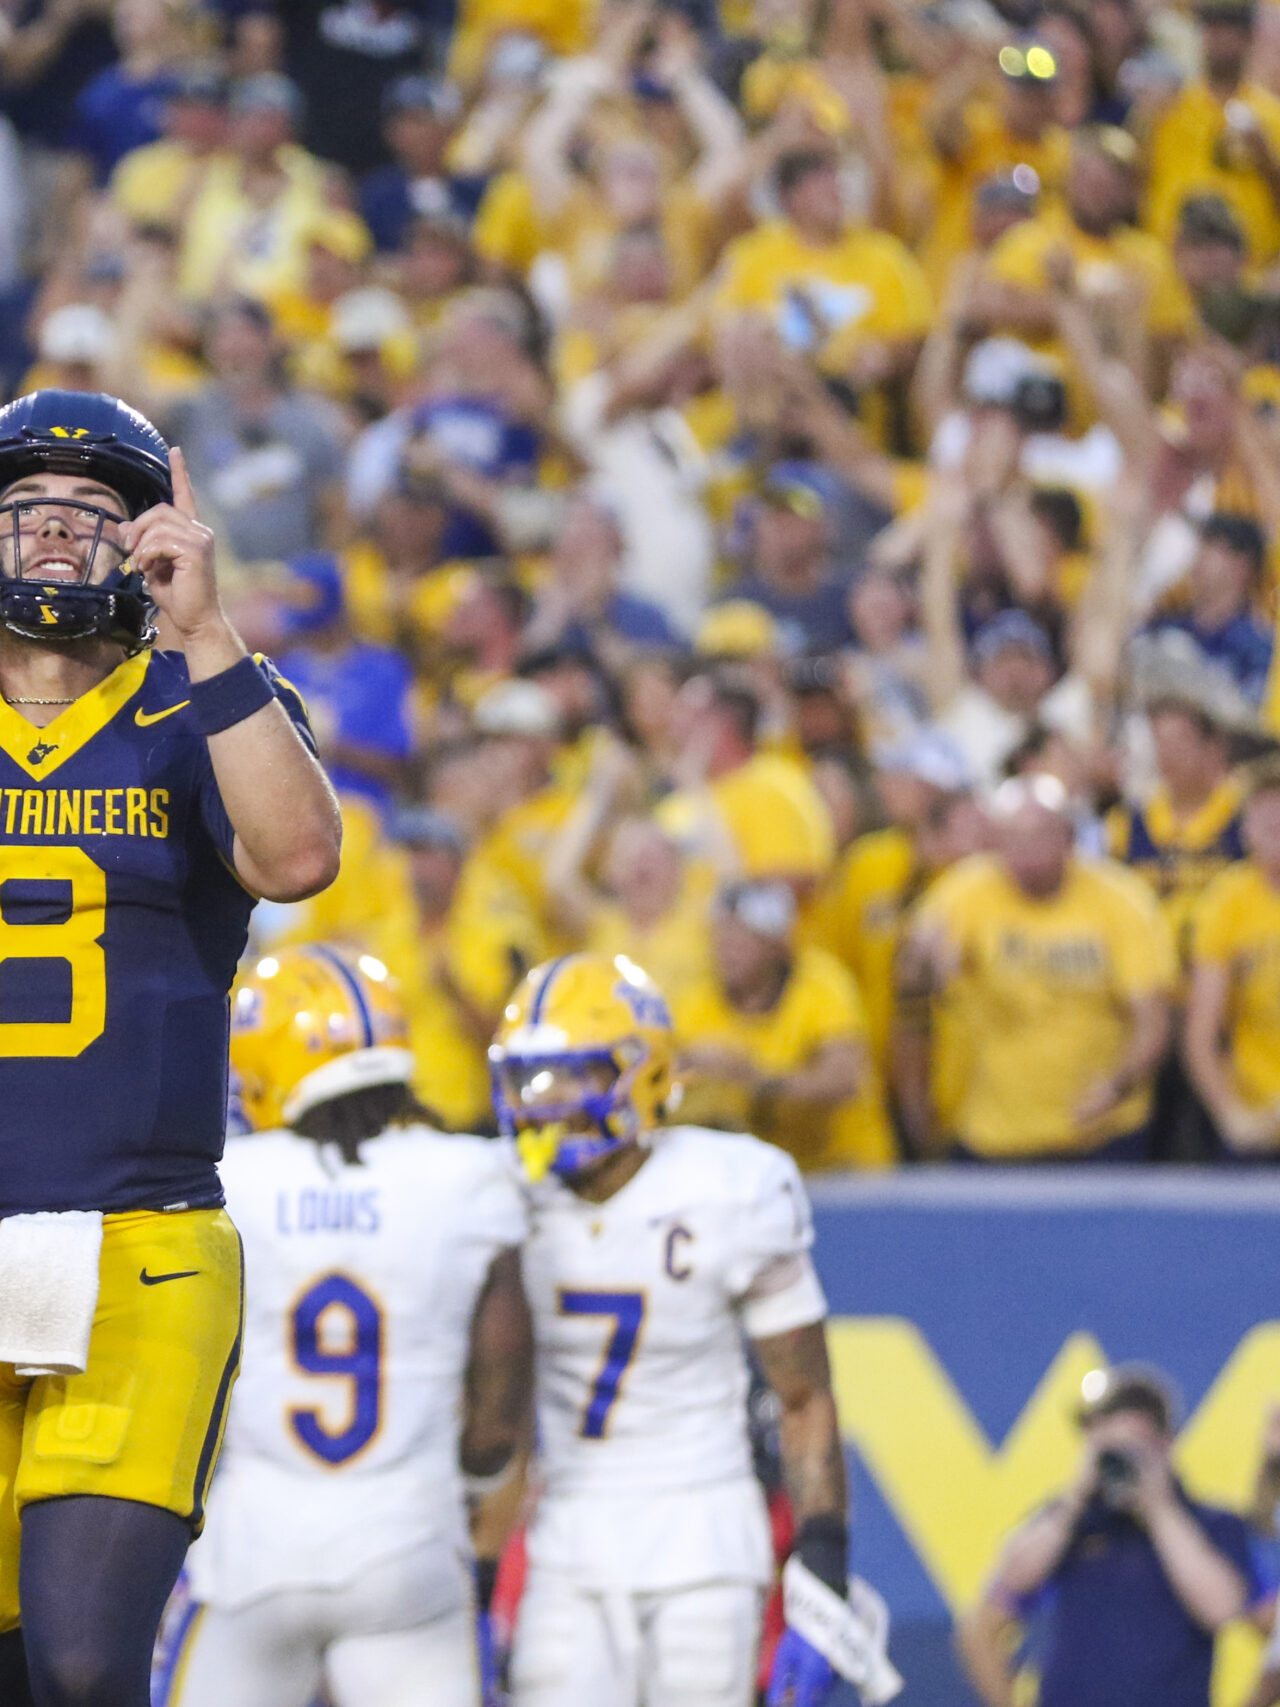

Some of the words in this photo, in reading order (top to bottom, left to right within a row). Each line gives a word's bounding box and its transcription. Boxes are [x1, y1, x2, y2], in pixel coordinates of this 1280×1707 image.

[275, 1187, 382, 1236] LOUIS
[664, 1221, 696, 1283] C
[283, 1266, 387, 1473] 9
[555, 1283, 652, 1442] 7
